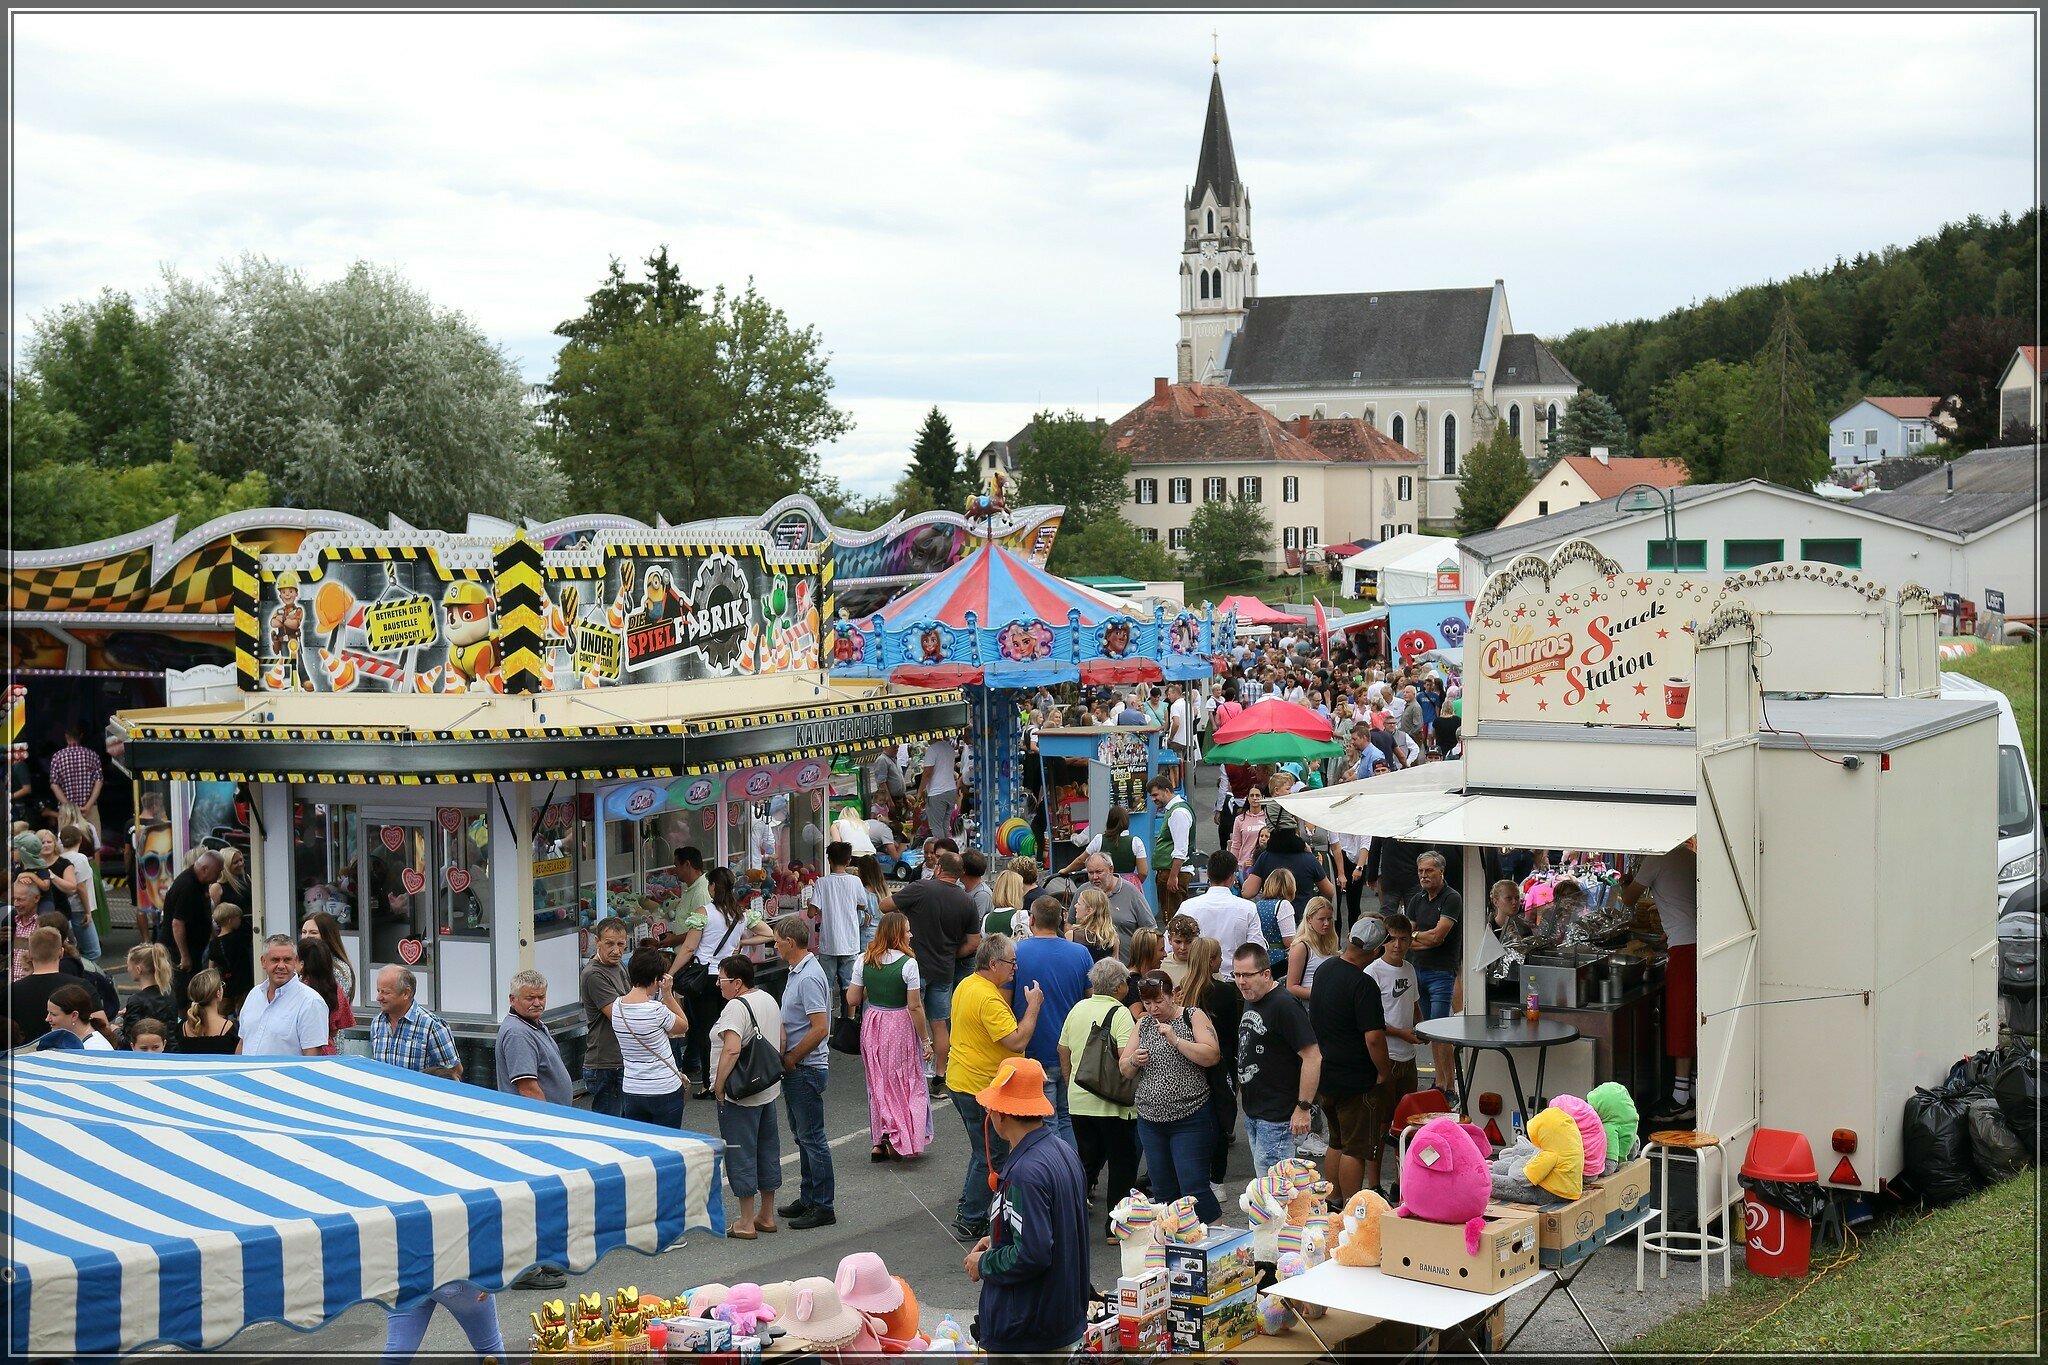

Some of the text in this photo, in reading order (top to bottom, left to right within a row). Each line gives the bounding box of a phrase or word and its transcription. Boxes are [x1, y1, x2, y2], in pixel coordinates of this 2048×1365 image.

[375, 605, 422, 621] BETRETEN DER
[628, 612, 647, 629] DIE
[383, 618, 419, 631] BAUSTELLE
[380, 629, 421, 644] ERWÜNSCHT
[1580, 600, 1668, 666] Snack
[580, 630, 614, 658] UNDER
[1481, 632, 1574, 679] Churros
[1563, 651, 1657, 706] Station
[795, 713, 893, 747] KAMMERHOFER
[1395, 978, 1408, 989] NIKE
[1419, 1262, 1450, 1276] BANANAS
[1509, 1262, 1526, 1275] BANANAS
[1121, 1290, 1137, 1298] CITY
